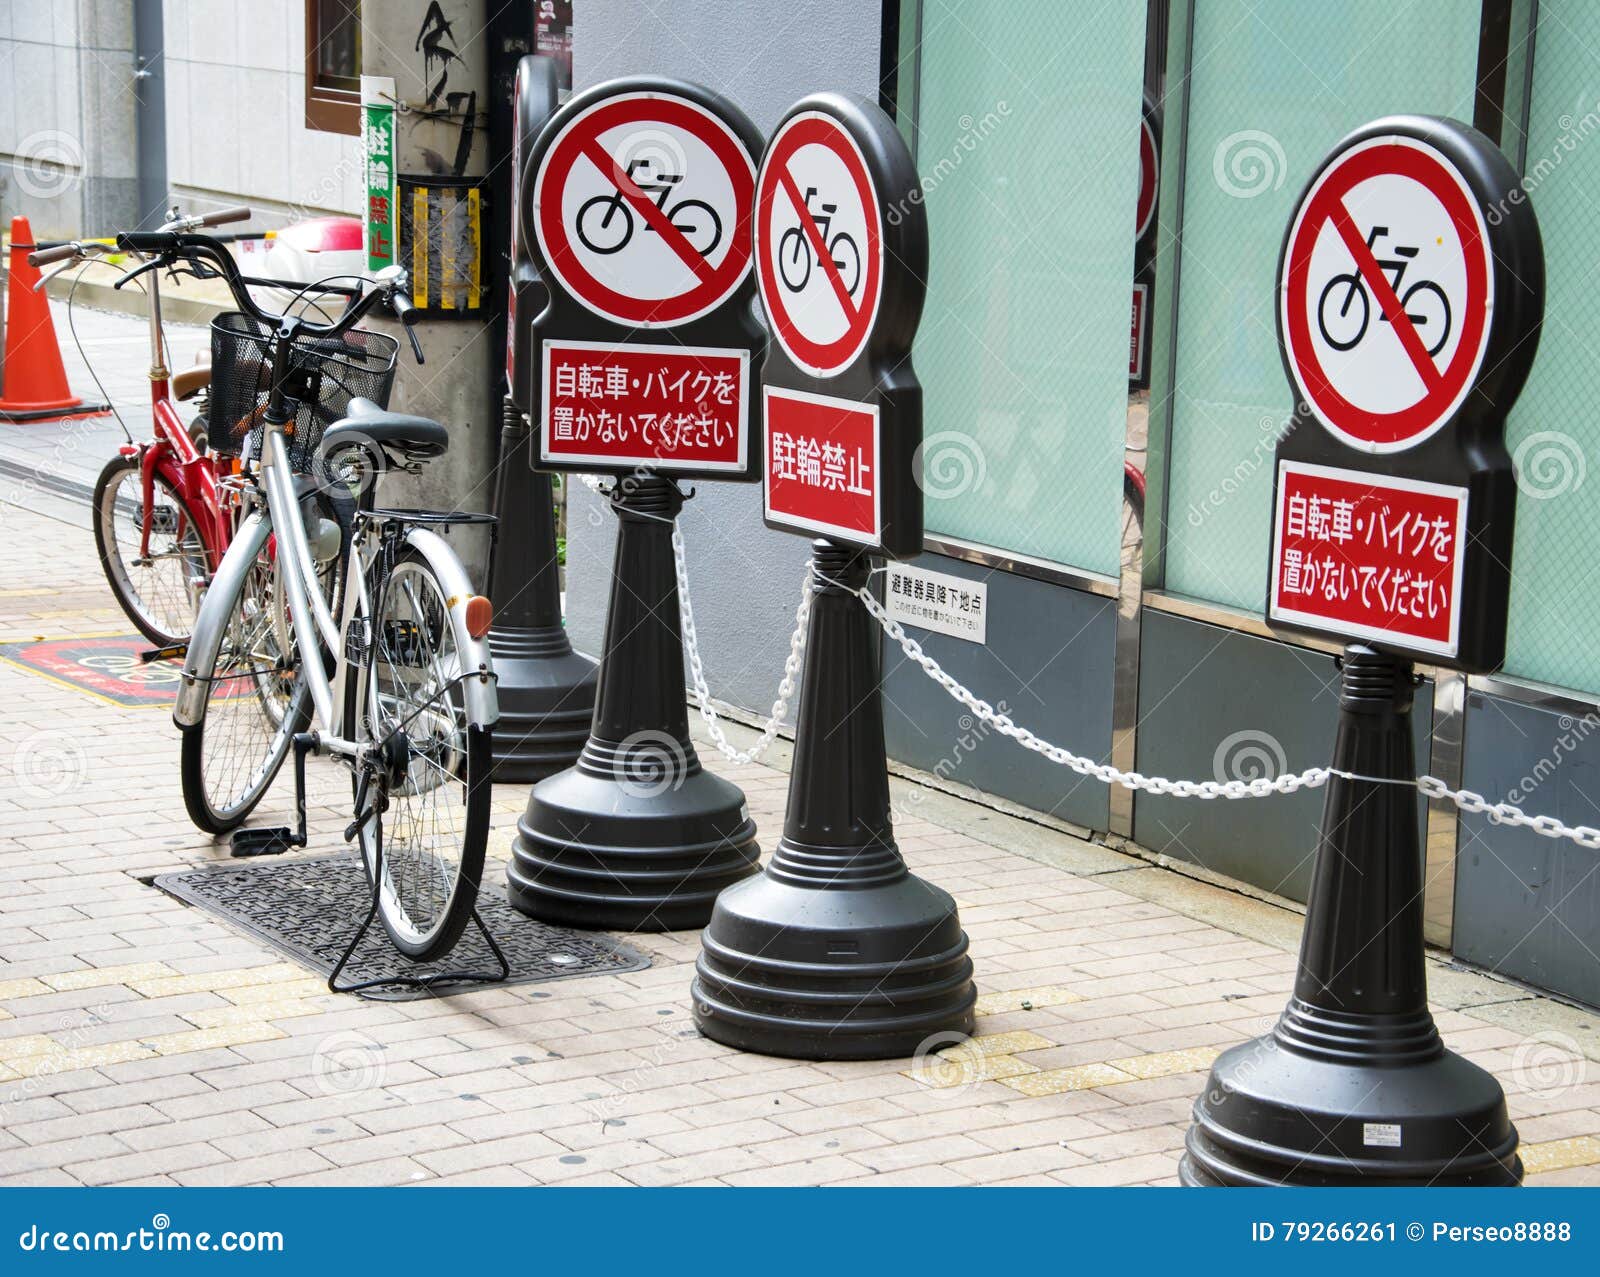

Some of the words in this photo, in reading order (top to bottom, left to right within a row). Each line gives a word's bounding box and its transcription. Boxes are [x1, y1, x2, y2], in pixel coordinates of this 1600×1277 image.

[555, 362, 736, 405] 自転車・バイクを
[554, 407, 734, 448] 置かないでください
[772, 431, 872, 496] 駐輪禁止
[1287, 490, 1452, 563] 自転車・バイクを
[891, 573, 982, 616] 避難器具降下地点
[1283, 548, 1447, 619] 置かないでください
